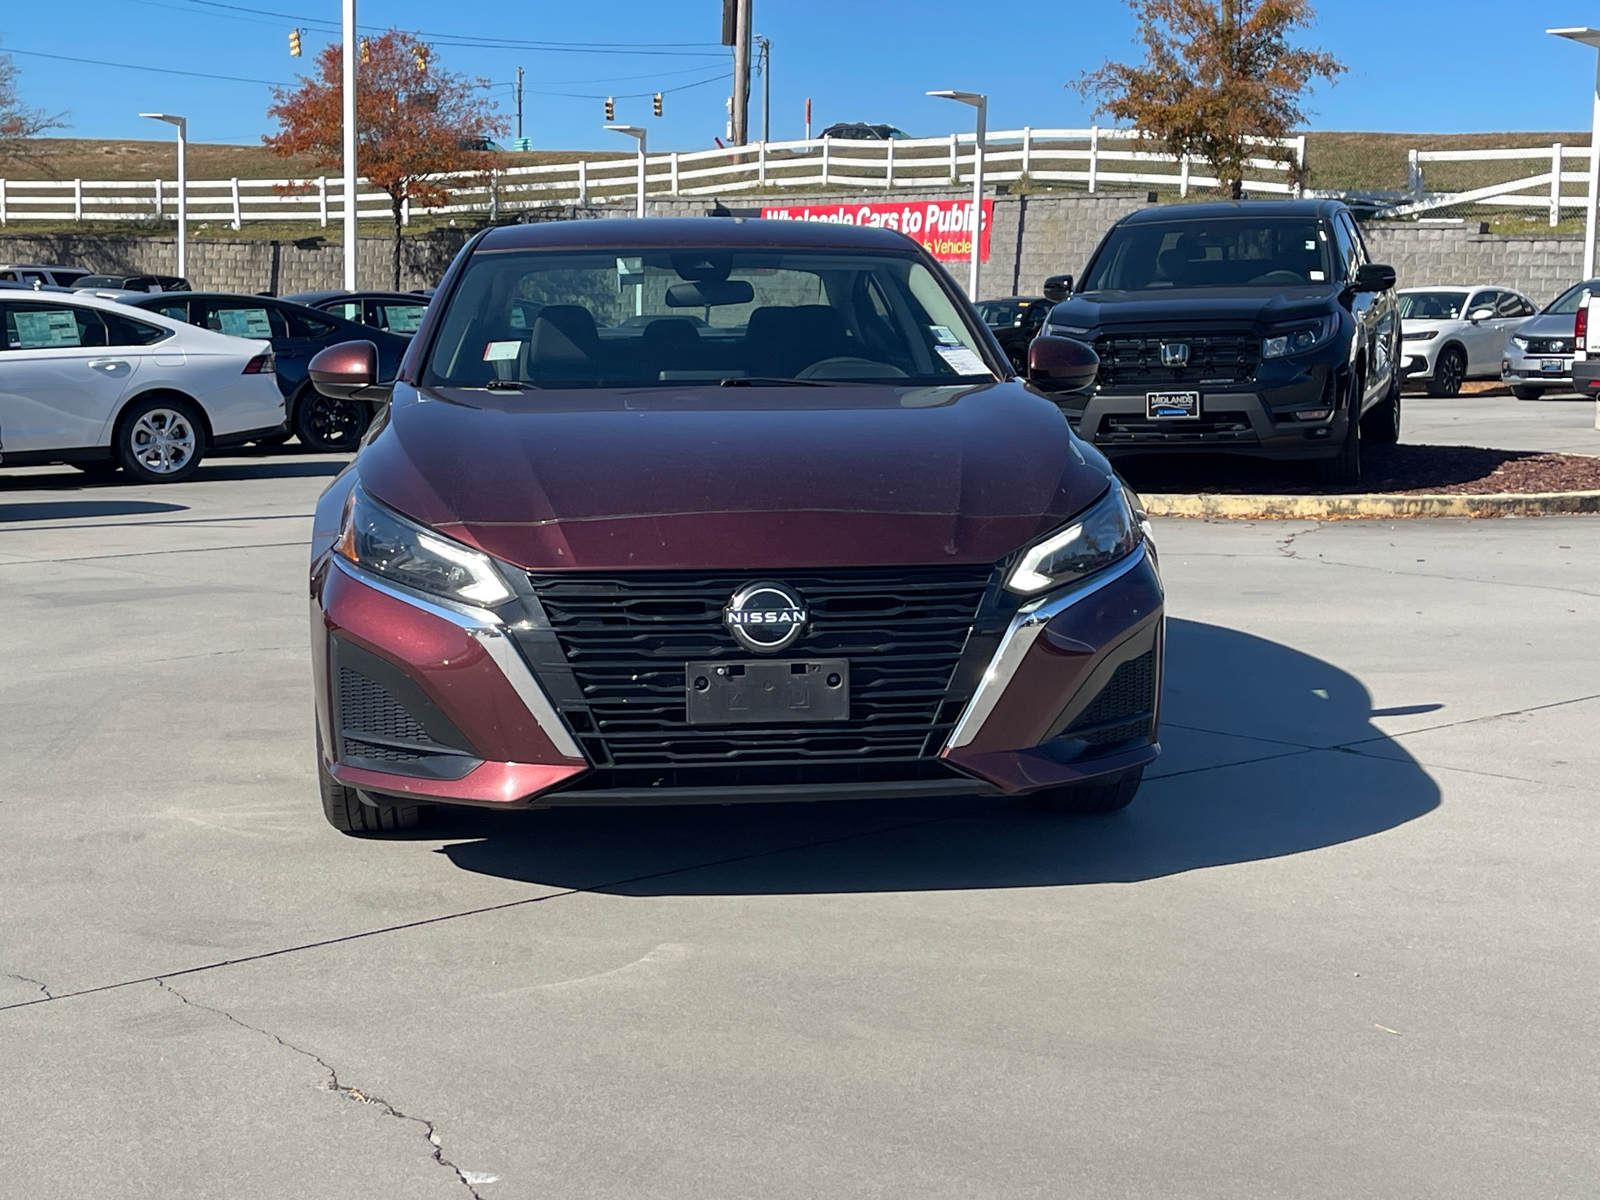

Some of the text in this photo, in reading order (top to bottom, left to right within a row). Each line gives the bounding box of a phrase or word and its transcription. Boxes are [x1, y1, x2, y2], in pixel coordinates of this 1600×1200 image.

[856, 206, 900, 230] Cars
[902, 207, 922, 234] to
[1151, 395, 1194, 404] MIDLANDS
[728, 610, 806, 623] NISSAN
